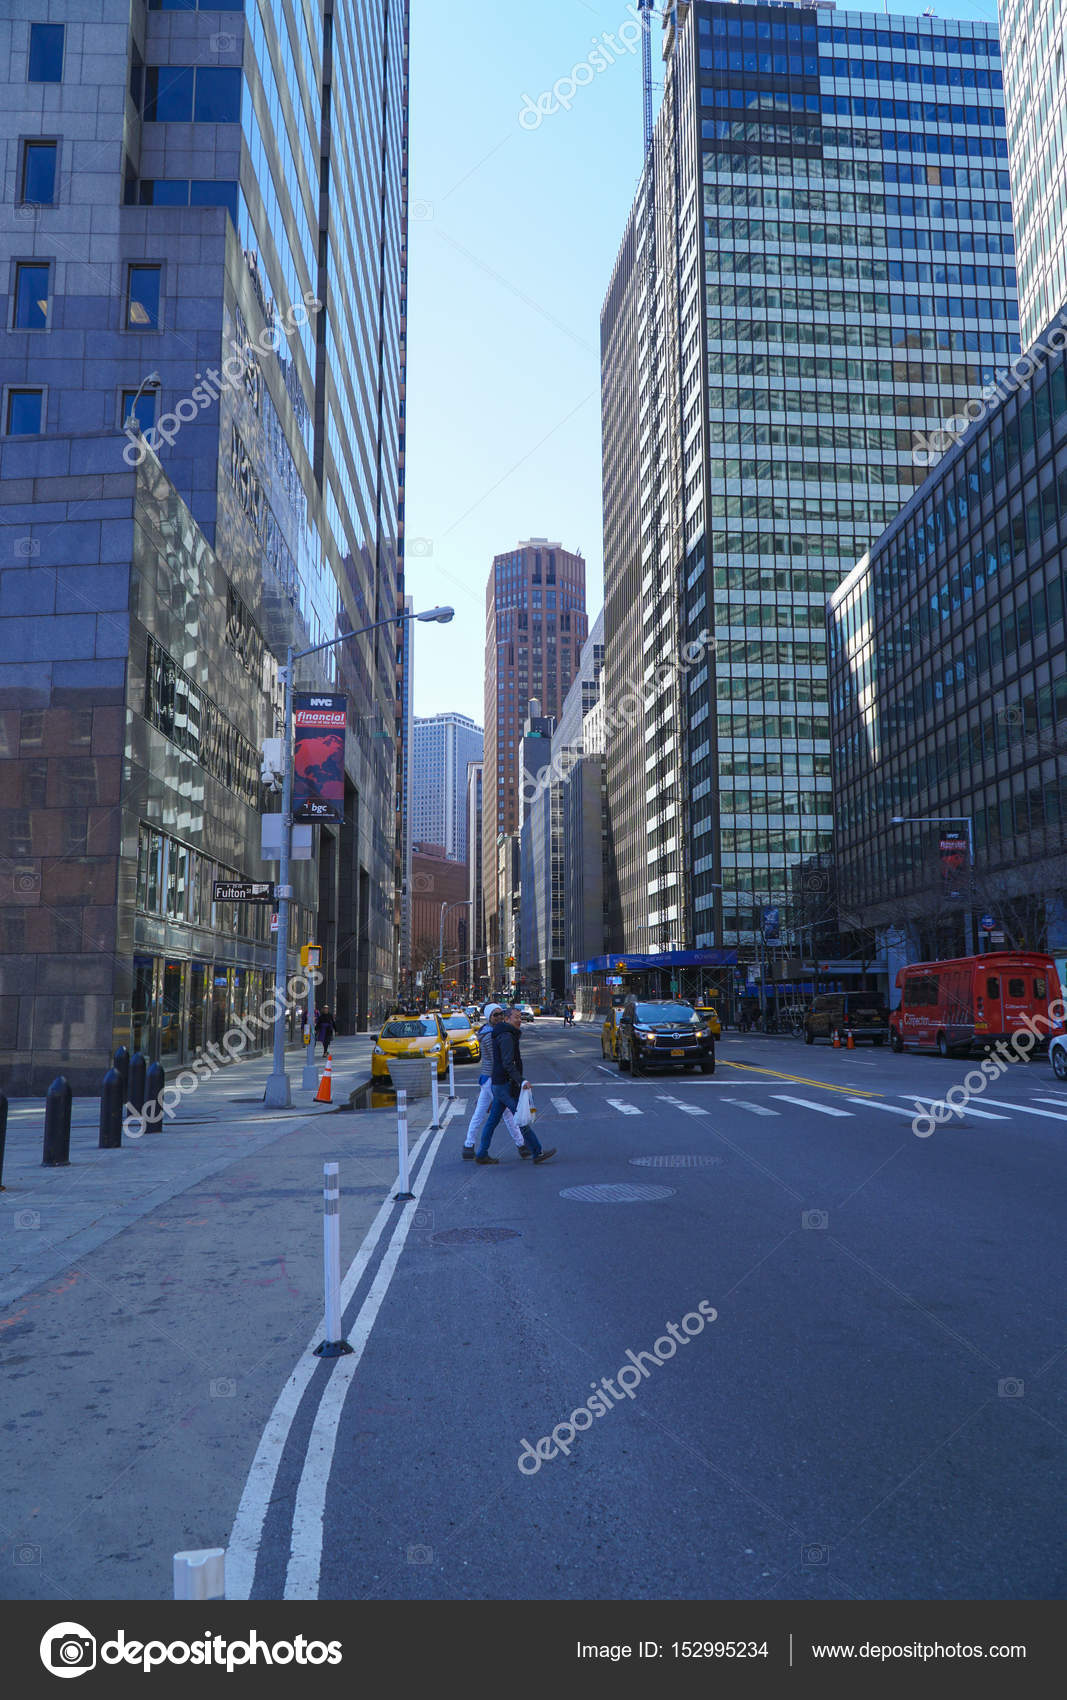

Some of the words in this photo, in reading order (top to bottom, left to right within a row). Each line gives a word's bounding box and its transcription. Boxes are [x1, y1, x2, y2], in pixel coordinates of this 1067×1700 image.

[310, 698, 332, 706] NYC
[297, 711, 345, 722] financial
[311, 803, 328, 813] bgc
[216, 887, 246, 898] Fulton
